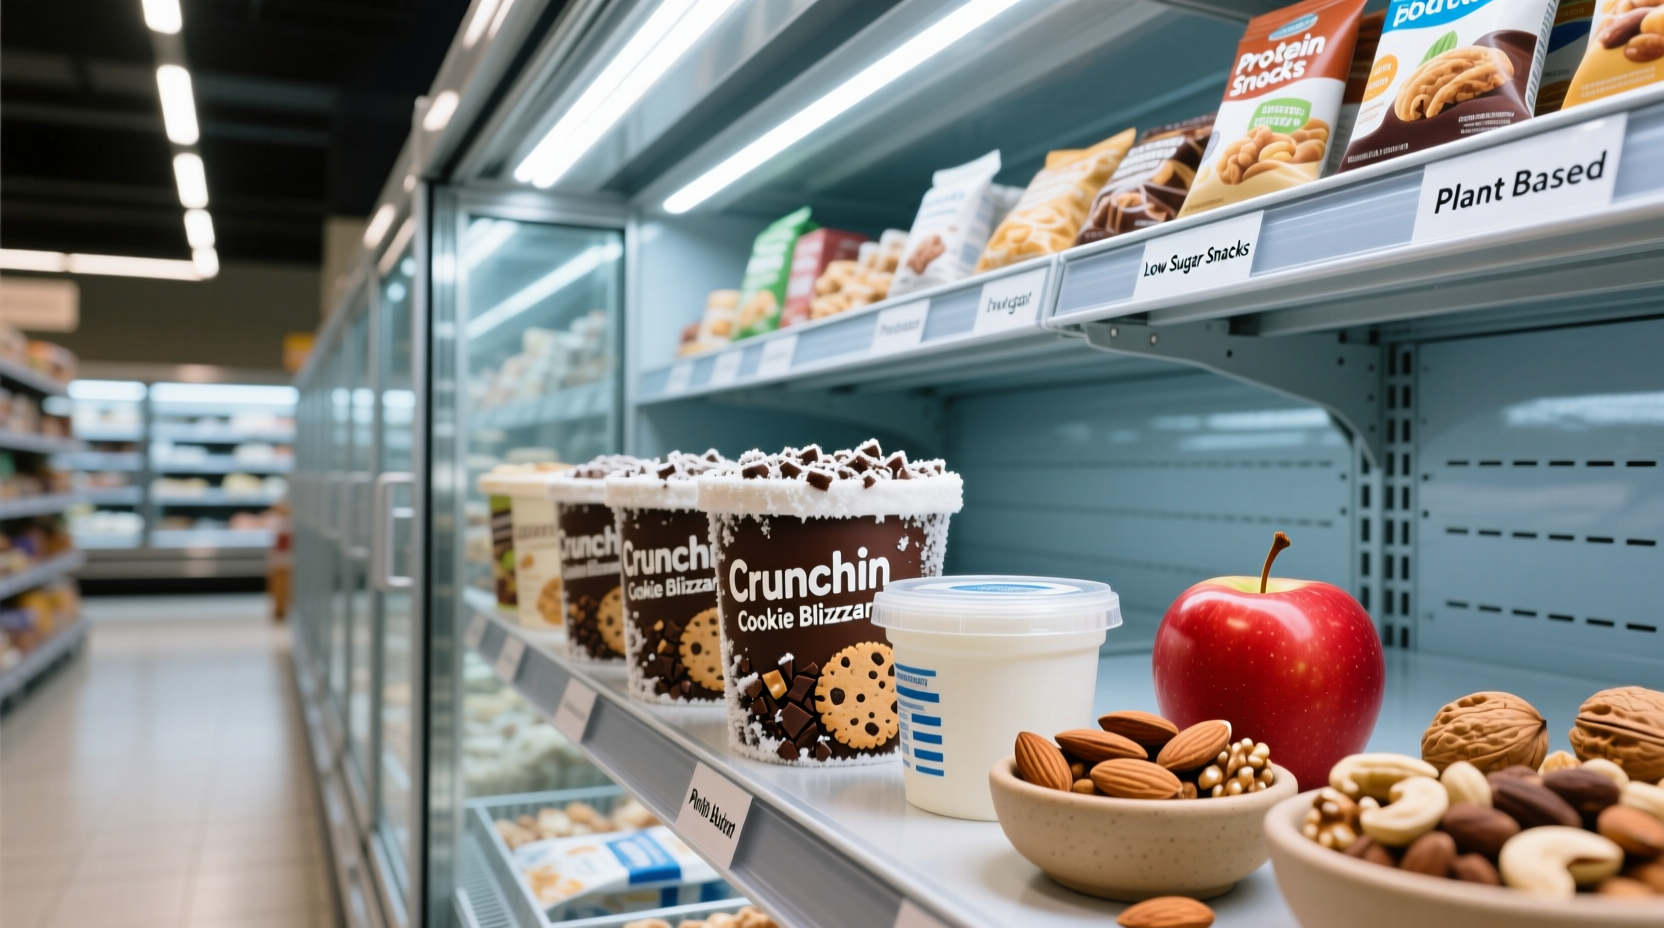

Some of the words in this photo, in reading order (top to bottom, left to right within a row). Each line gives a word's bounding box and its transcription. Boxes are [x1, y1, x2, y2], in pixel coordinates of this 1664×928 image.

[1235, 33, 1326, 75] Protein
[1434, 176, 1505, 214] Plant
[1512, 150, 1607, 197] Based
[1143, 261, 1167, 277] Low
[1169, 254, 1204, 274] Sugar
[1205, 239, 1251, 264] Snacks
[729, 546, 890, 602] Crunchin
[737, 607, 794, 632] Cookie
